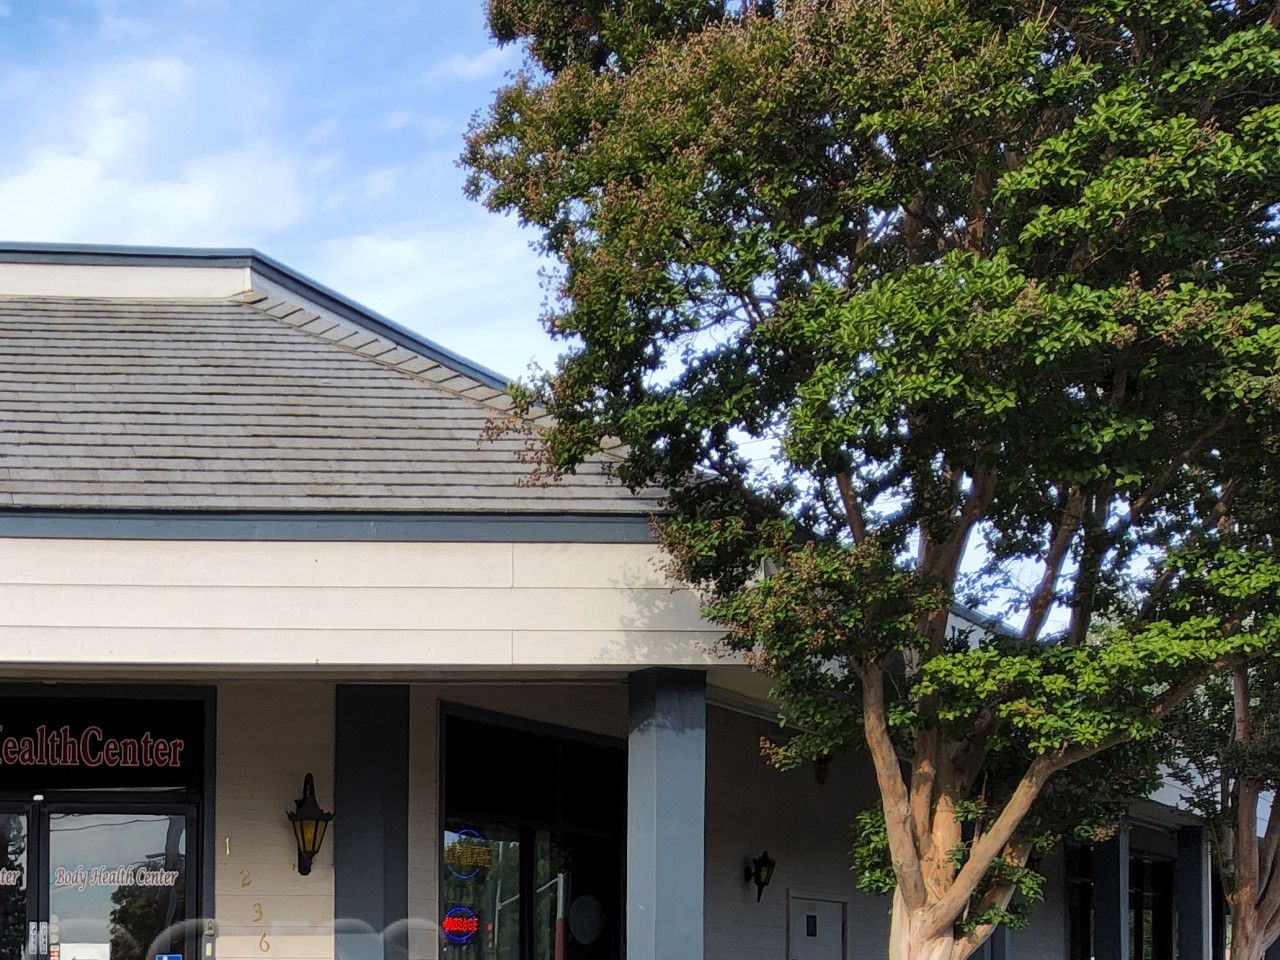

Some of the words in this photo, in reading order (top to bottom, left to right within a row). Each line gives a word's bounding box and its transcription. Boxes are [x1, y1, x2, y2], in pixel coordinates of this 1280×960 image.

[55, 865, 88, 892] Body
[89, 864, 134, 886] Health
[136, 867, 179, 886] Center
